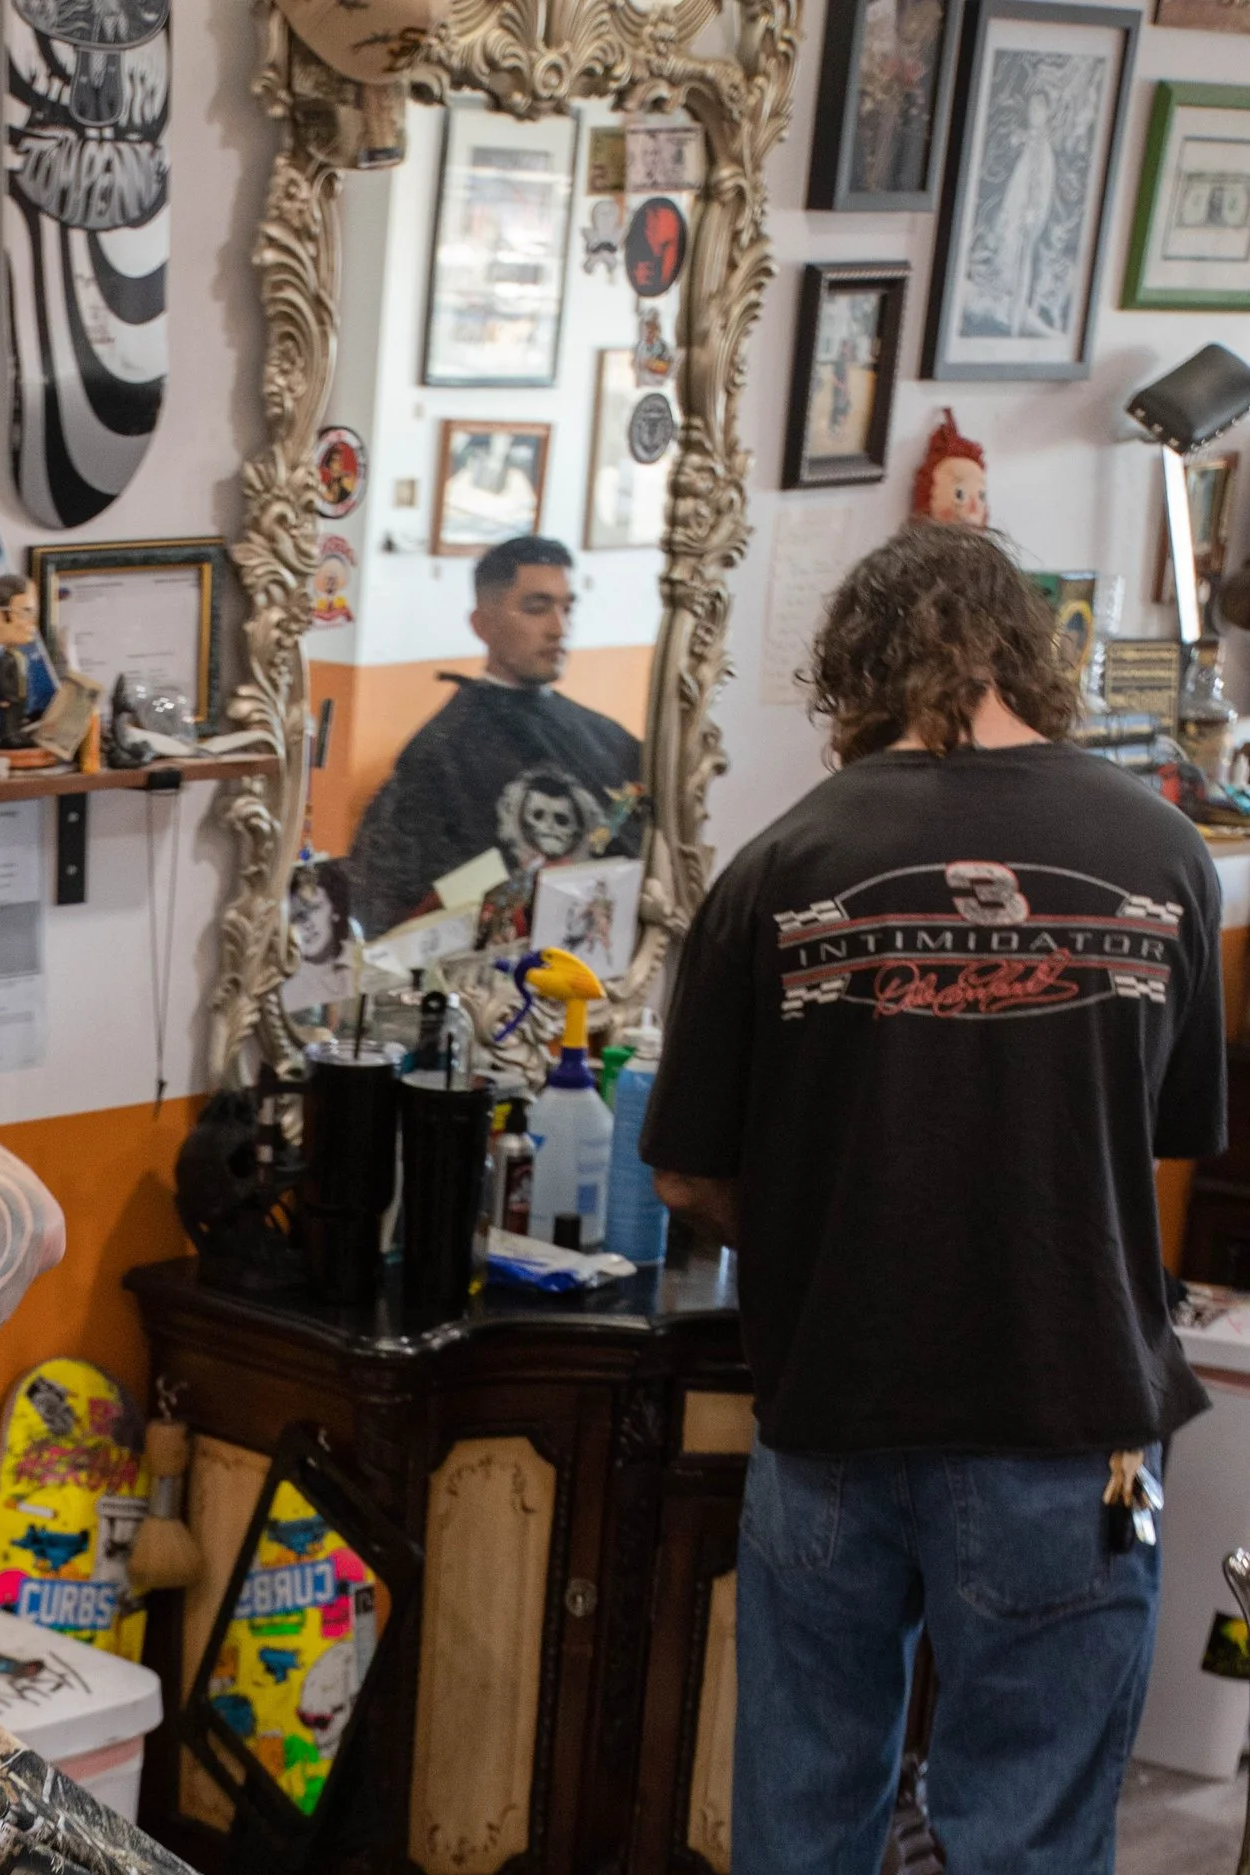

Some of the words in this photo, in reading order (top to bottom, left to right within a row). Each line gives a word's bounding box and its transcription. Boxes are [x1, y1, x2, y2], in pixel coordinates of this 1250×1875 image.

[945, 860, 1031, 926] 3
[798, 930, 1167, 968] INTIMIDATOR
[18, 1580, 116, 1627] CURBS
